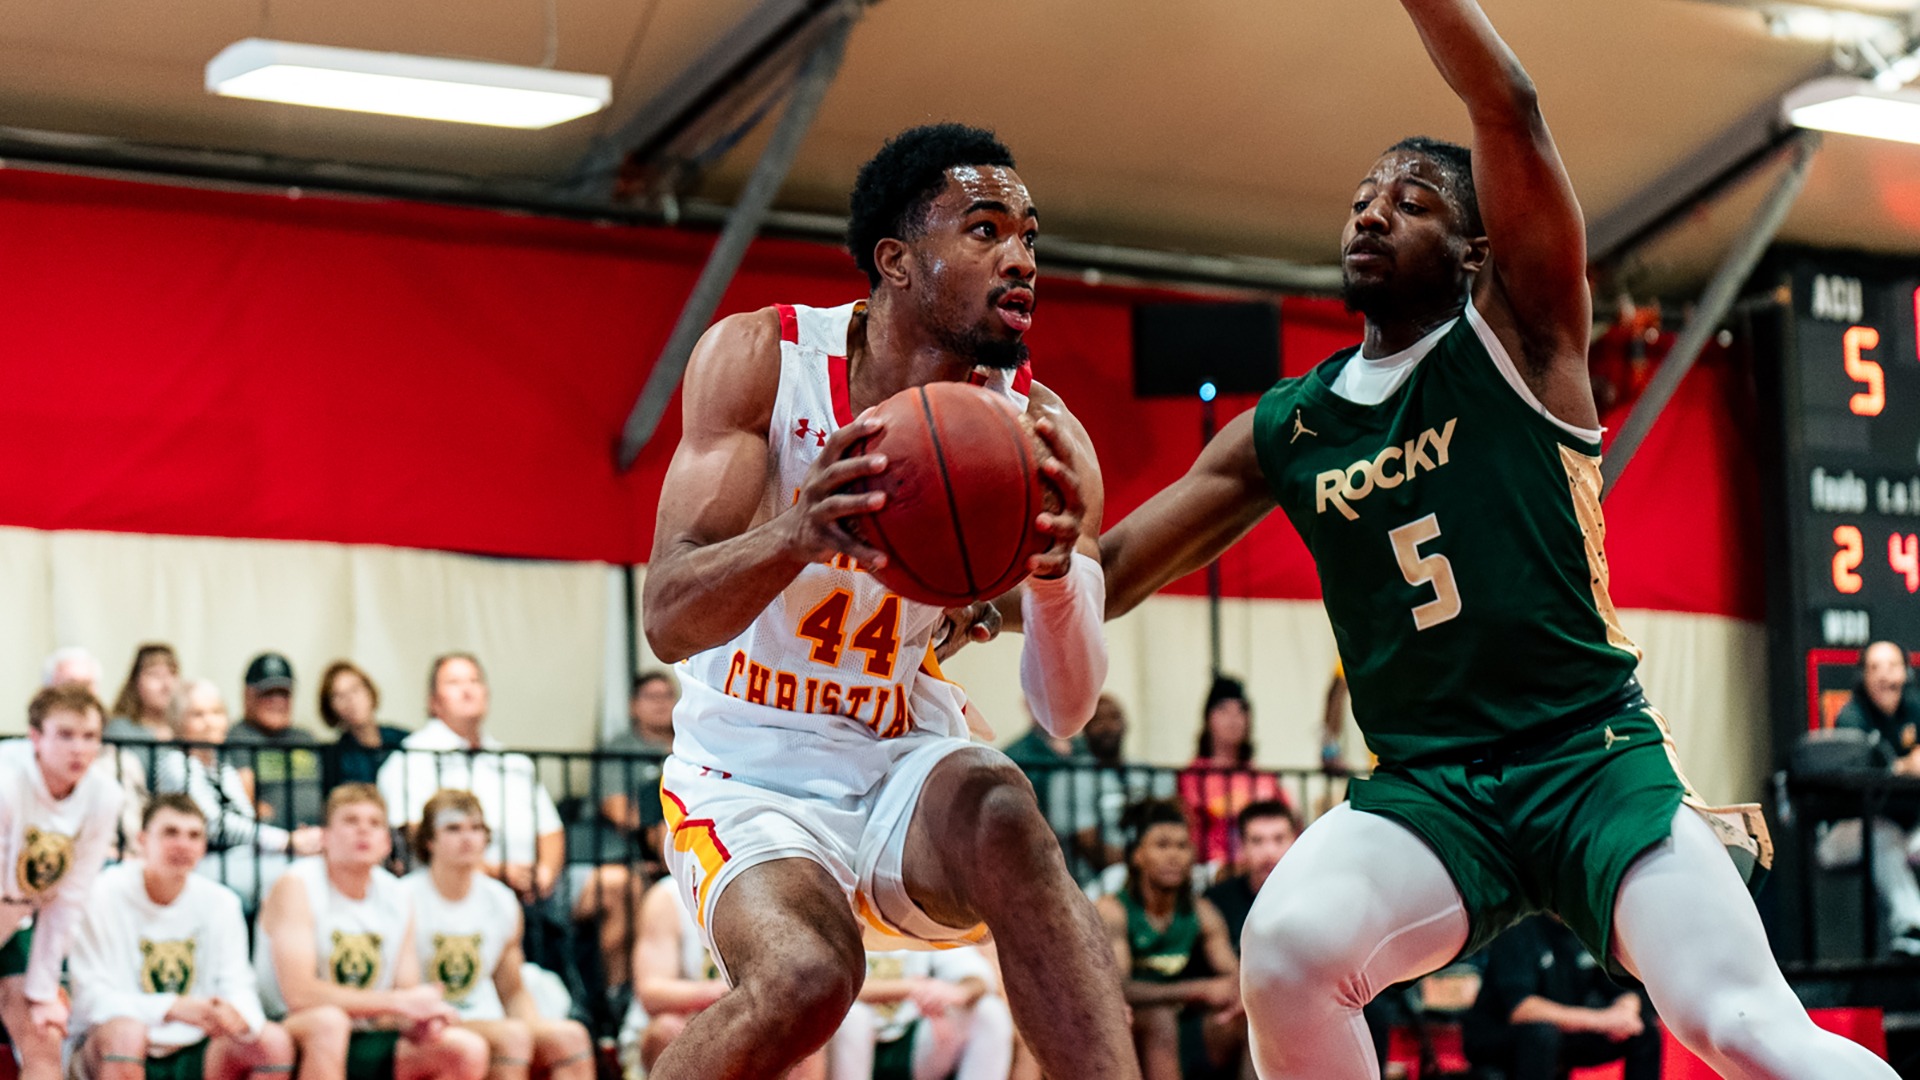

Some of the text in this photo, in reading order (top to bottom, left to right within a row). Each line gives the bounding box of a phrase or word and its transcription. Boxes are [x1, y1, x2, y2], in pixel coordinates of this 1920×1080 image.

[1843, 326, 1886, 416] 5
[1316, 417, 1457, 521] ROCKY
[1388, 512, 1462, 631] 5
[1832, 525, 1864, 594] 2
[1888, 532, 1919, 593] 4
[796, 587, 901, 680] 44
[725, 649, 913, 739] CHRISTIA
